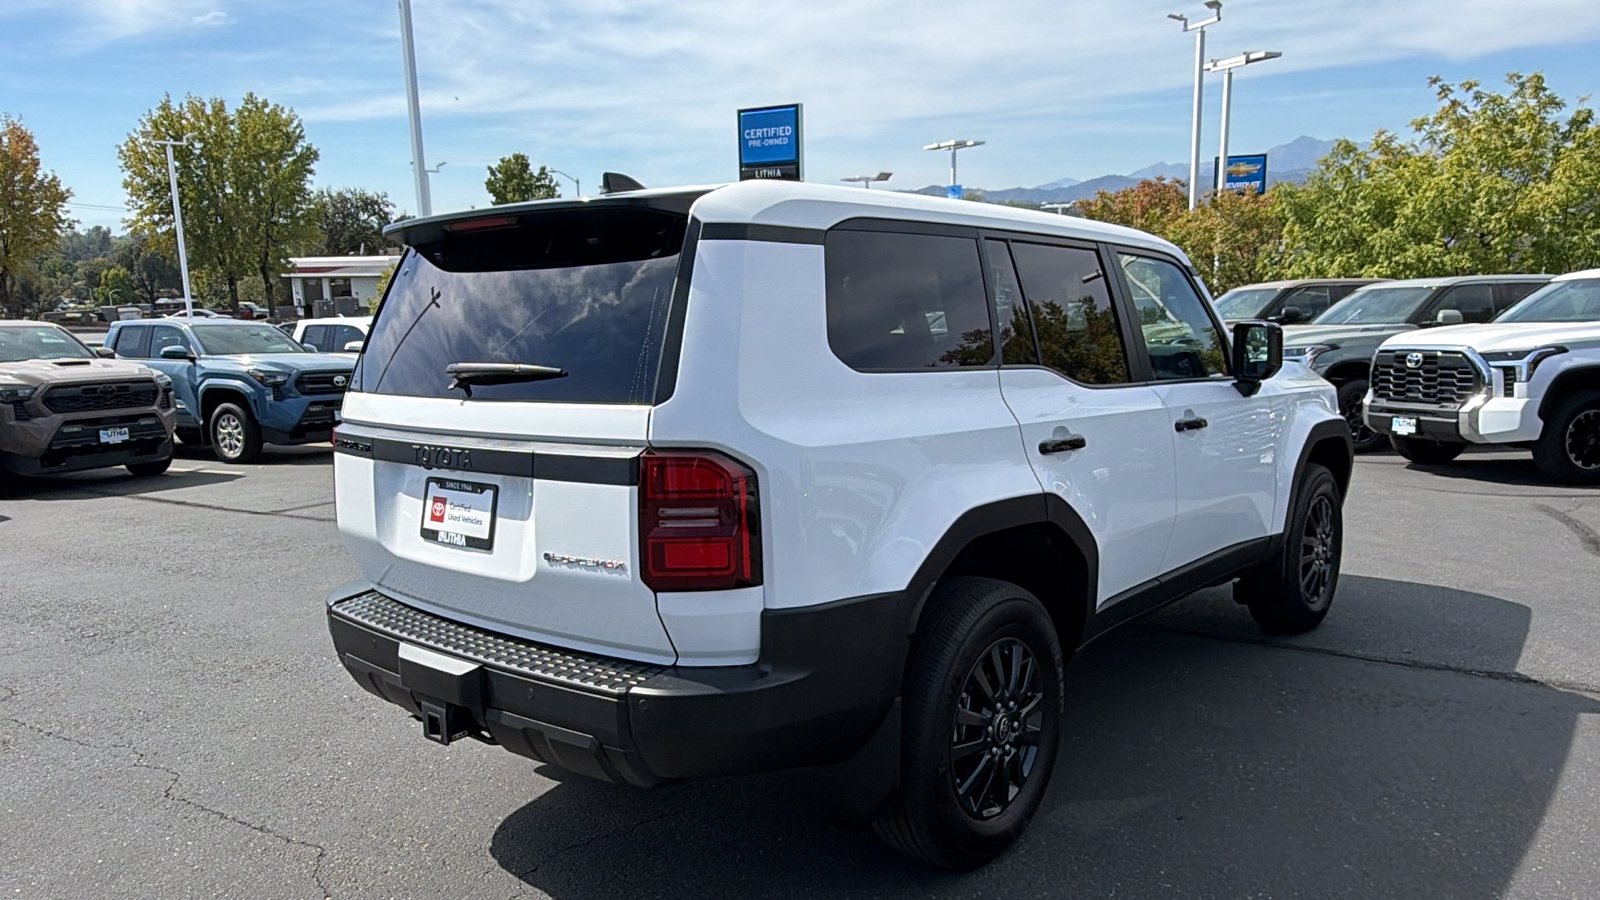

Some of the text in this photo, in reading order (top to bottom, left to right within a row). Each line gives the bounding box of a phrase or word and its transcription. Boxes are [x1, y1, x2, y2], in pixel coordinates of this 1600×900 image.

[744, 126, 792, 139] CERTIFIED
[749, 137, 788, 147] PRE-OWNED
[755, 169, 782, 178] LITHIA
[412, 444, 474, 468] TOYOTA
[445, 481, 473, 492] SINCE 1946
[449, 502, 472, 513] Certified
[447, 513, 483, 526] Used Vehicles
